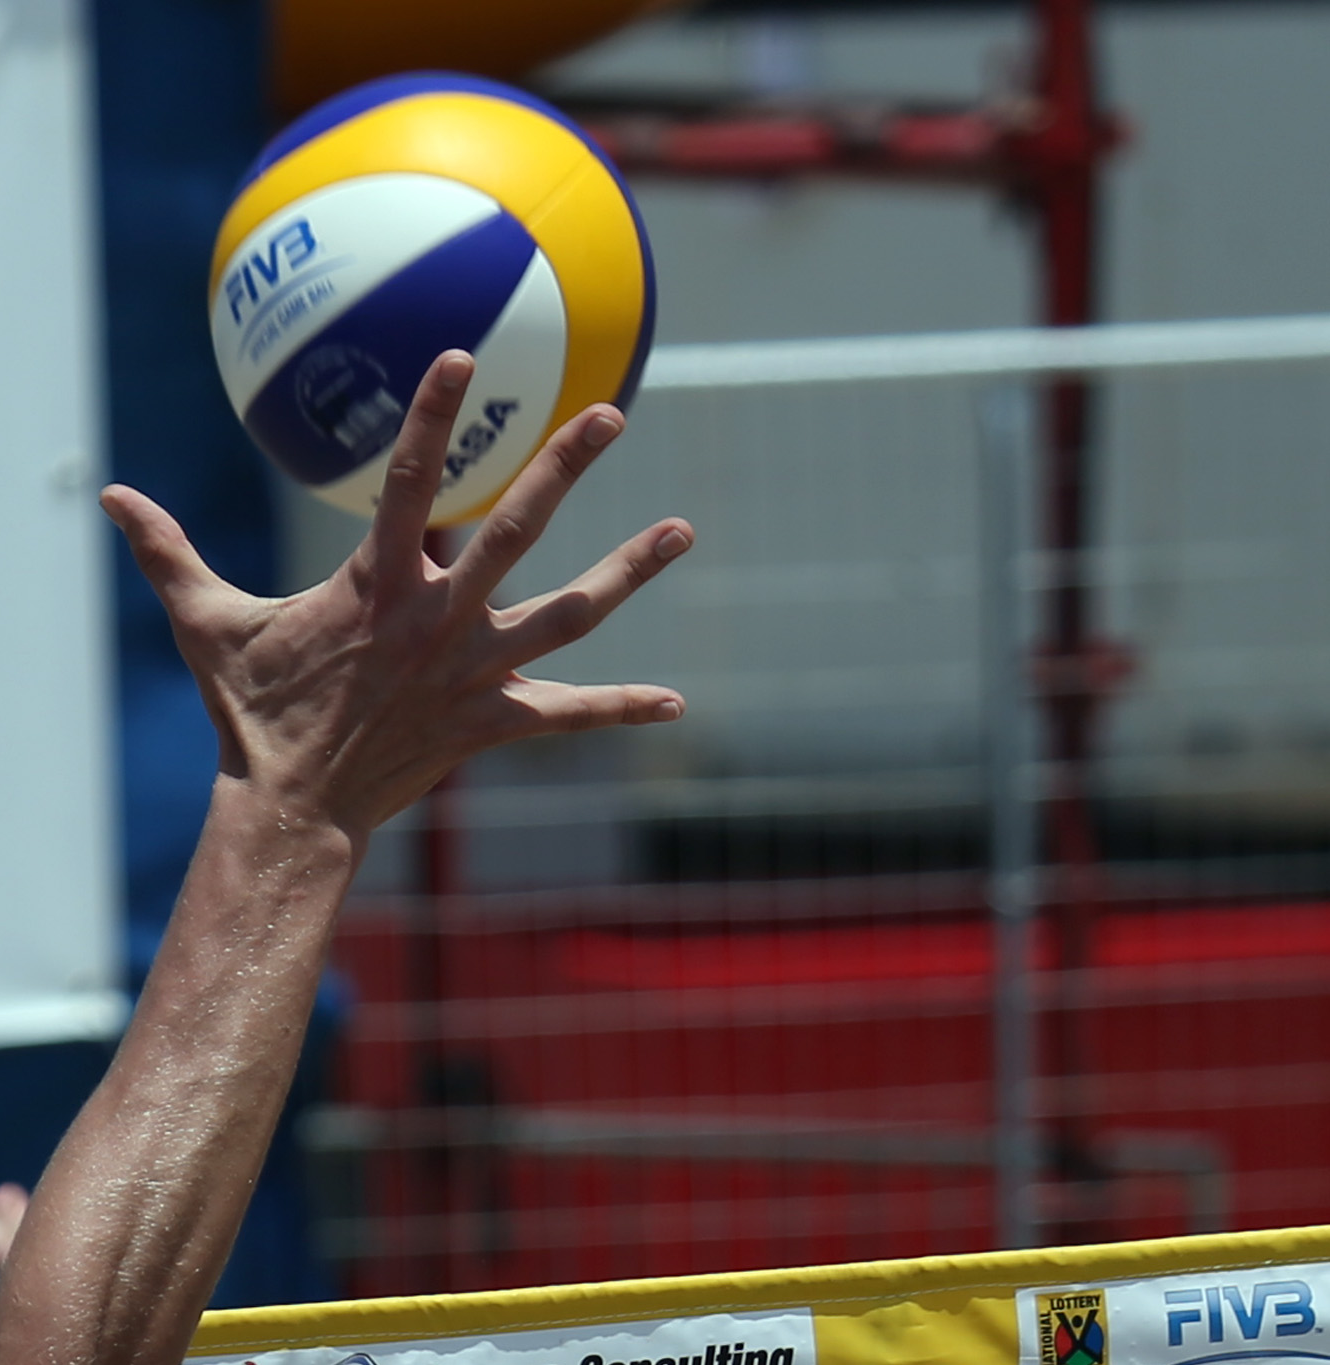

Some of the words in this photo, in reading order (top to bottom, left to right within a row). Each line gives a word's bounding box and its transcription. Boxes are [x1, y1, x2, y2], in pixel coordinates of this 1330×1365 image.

[225, 216, 316, 326] FIVB
[1051, 1294, 1101, 1311] LOTTERY
[1164, 1280, 1317, 1347] FIVB
